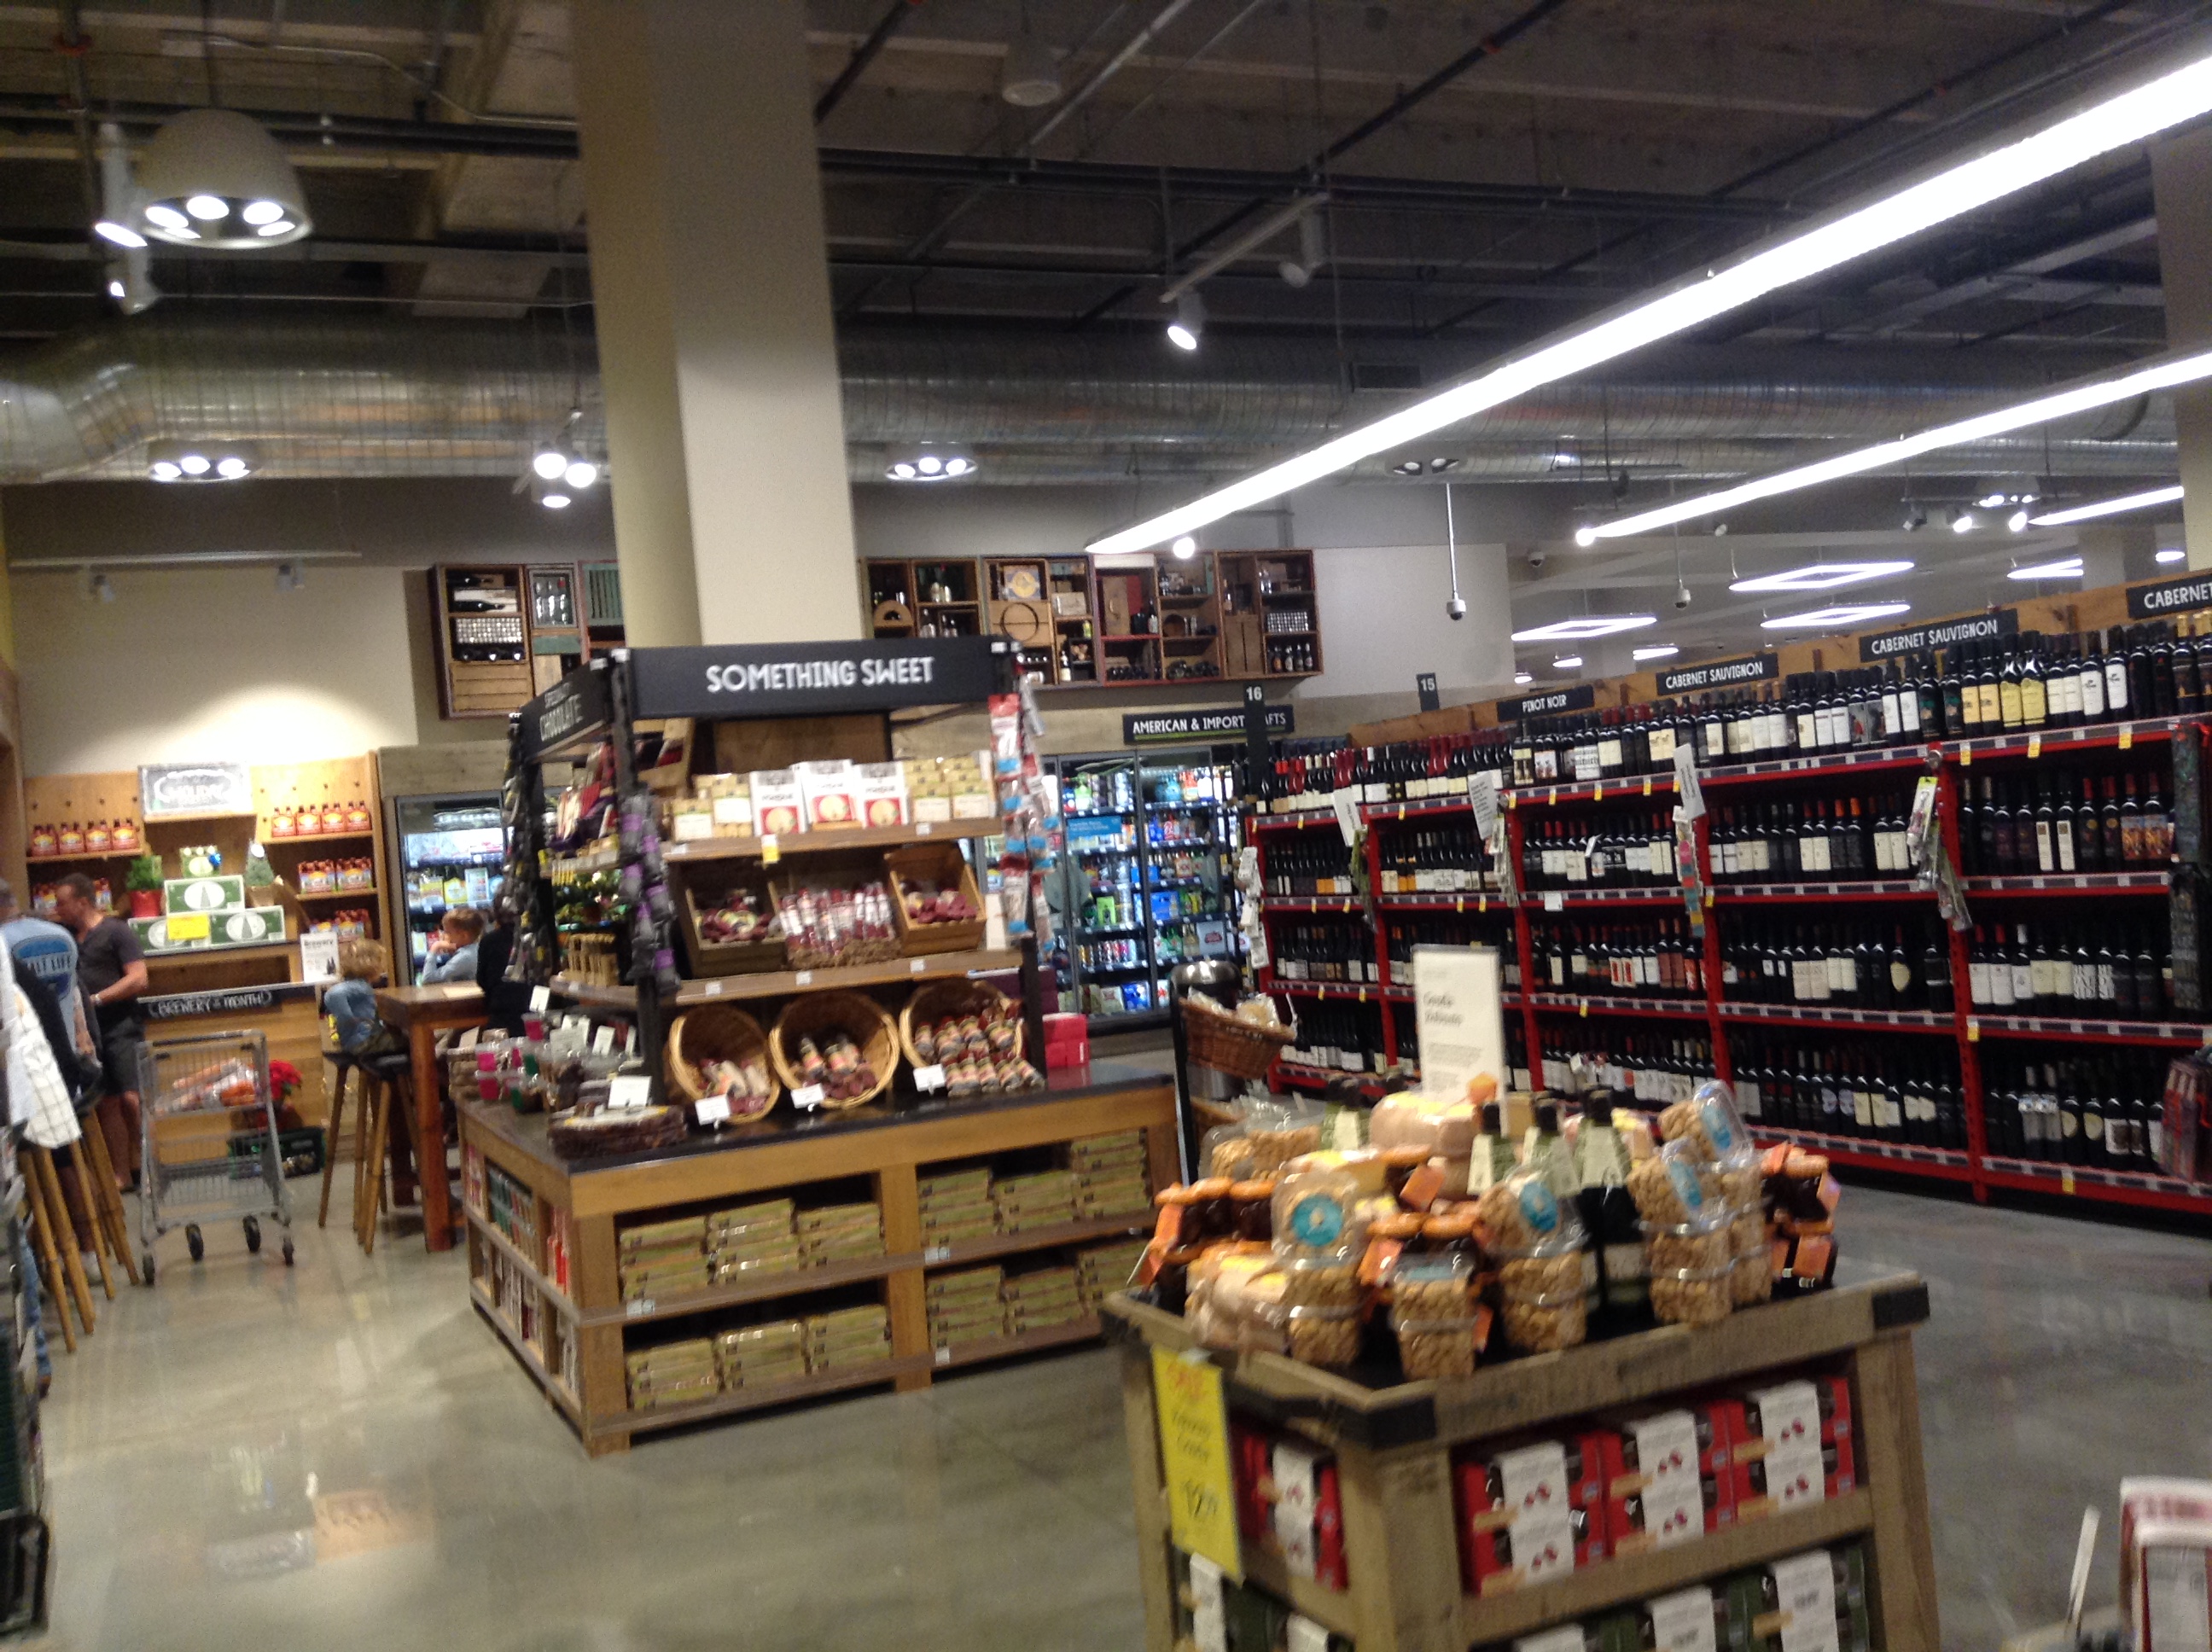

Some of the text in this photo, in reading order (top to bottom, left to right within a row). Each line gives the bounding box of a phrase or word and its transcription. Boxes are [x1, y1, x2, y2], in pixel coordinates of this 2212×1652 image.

[1871, 620, 1998, 654] CABERNET SAUVIGNON
[706, 656, 934, 692] SOMETHING SWEET
[1420, 678, 1435, 691] 15
[1665, 661, 1763, 689] CABERNET SAUVIGNON
[1246, 686, 1262, 701] 16
[1522, 694, 1567, 713] PINOT NOIR
[539, 693, 583, 742] CHOCOLATE
[1132, 718, 1188, 735] AMERICAN
[1190, 717, 1200, 731] &
[1202, 715, 1245, 730] IMPORT
